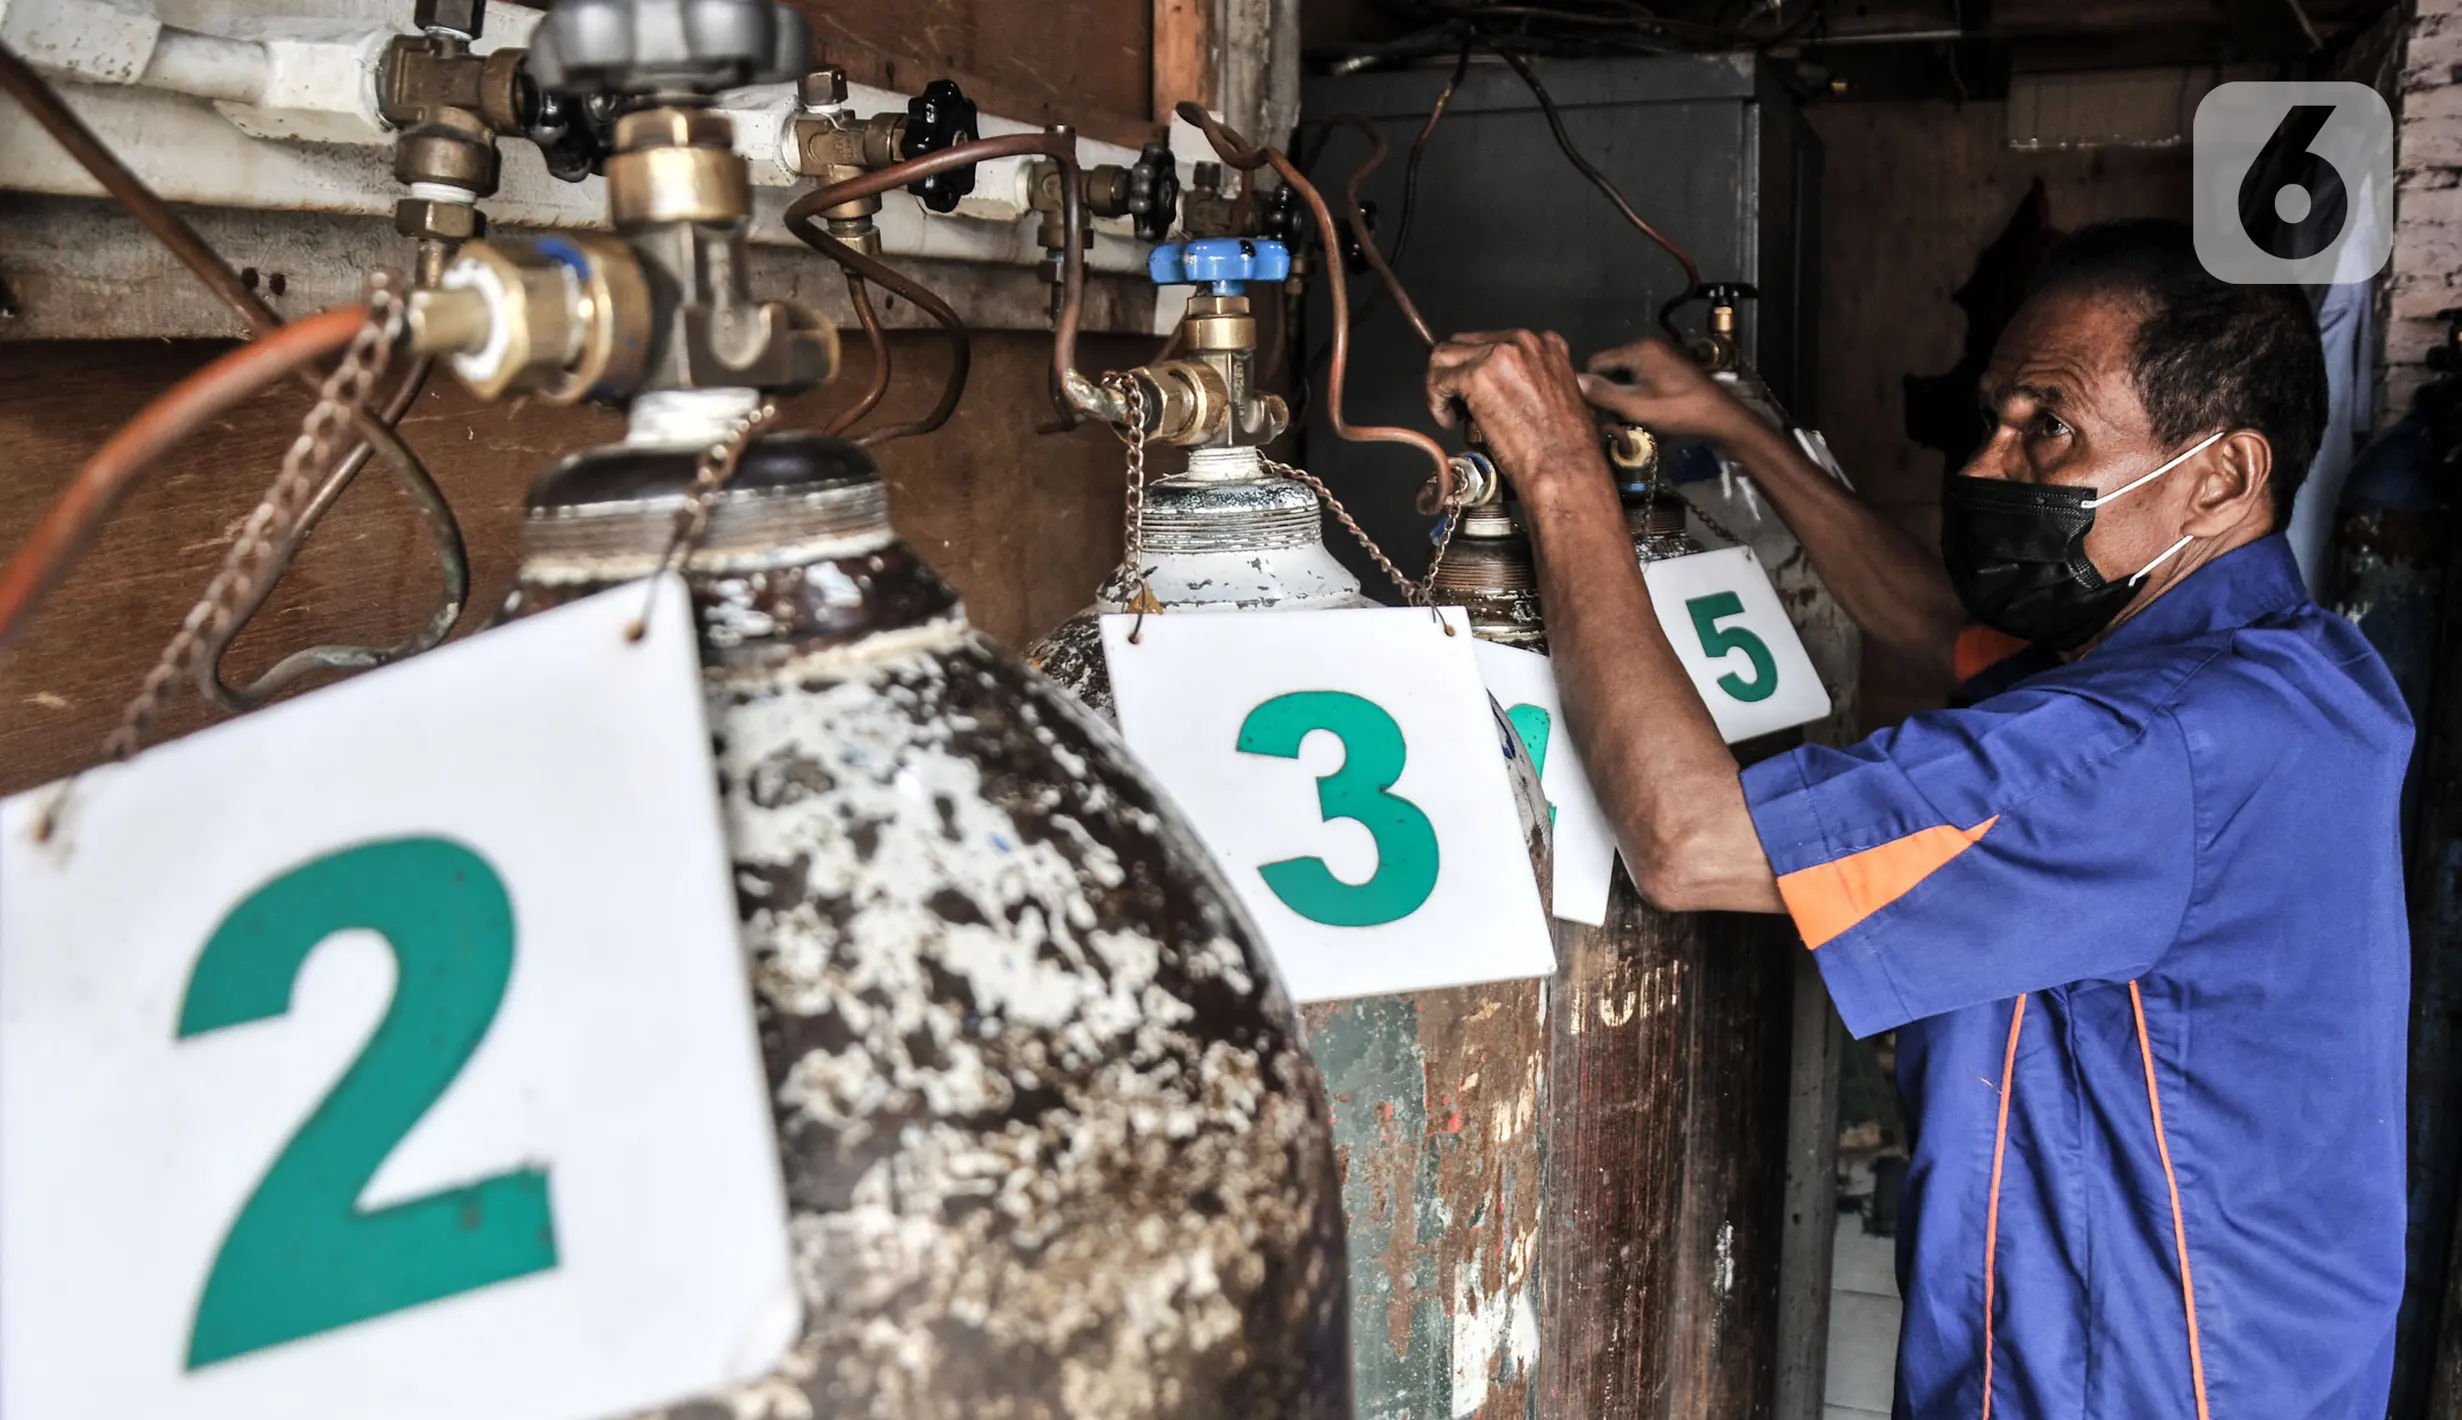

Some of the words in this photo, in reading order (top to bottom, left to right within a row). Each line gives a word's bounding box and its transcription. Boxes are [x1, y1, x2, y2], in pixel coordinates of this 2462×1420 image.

[1685, 591, 1778, 702] 5
[1236, 690, 1440, 927] 3
[177, 834, 560, 1373] 2
